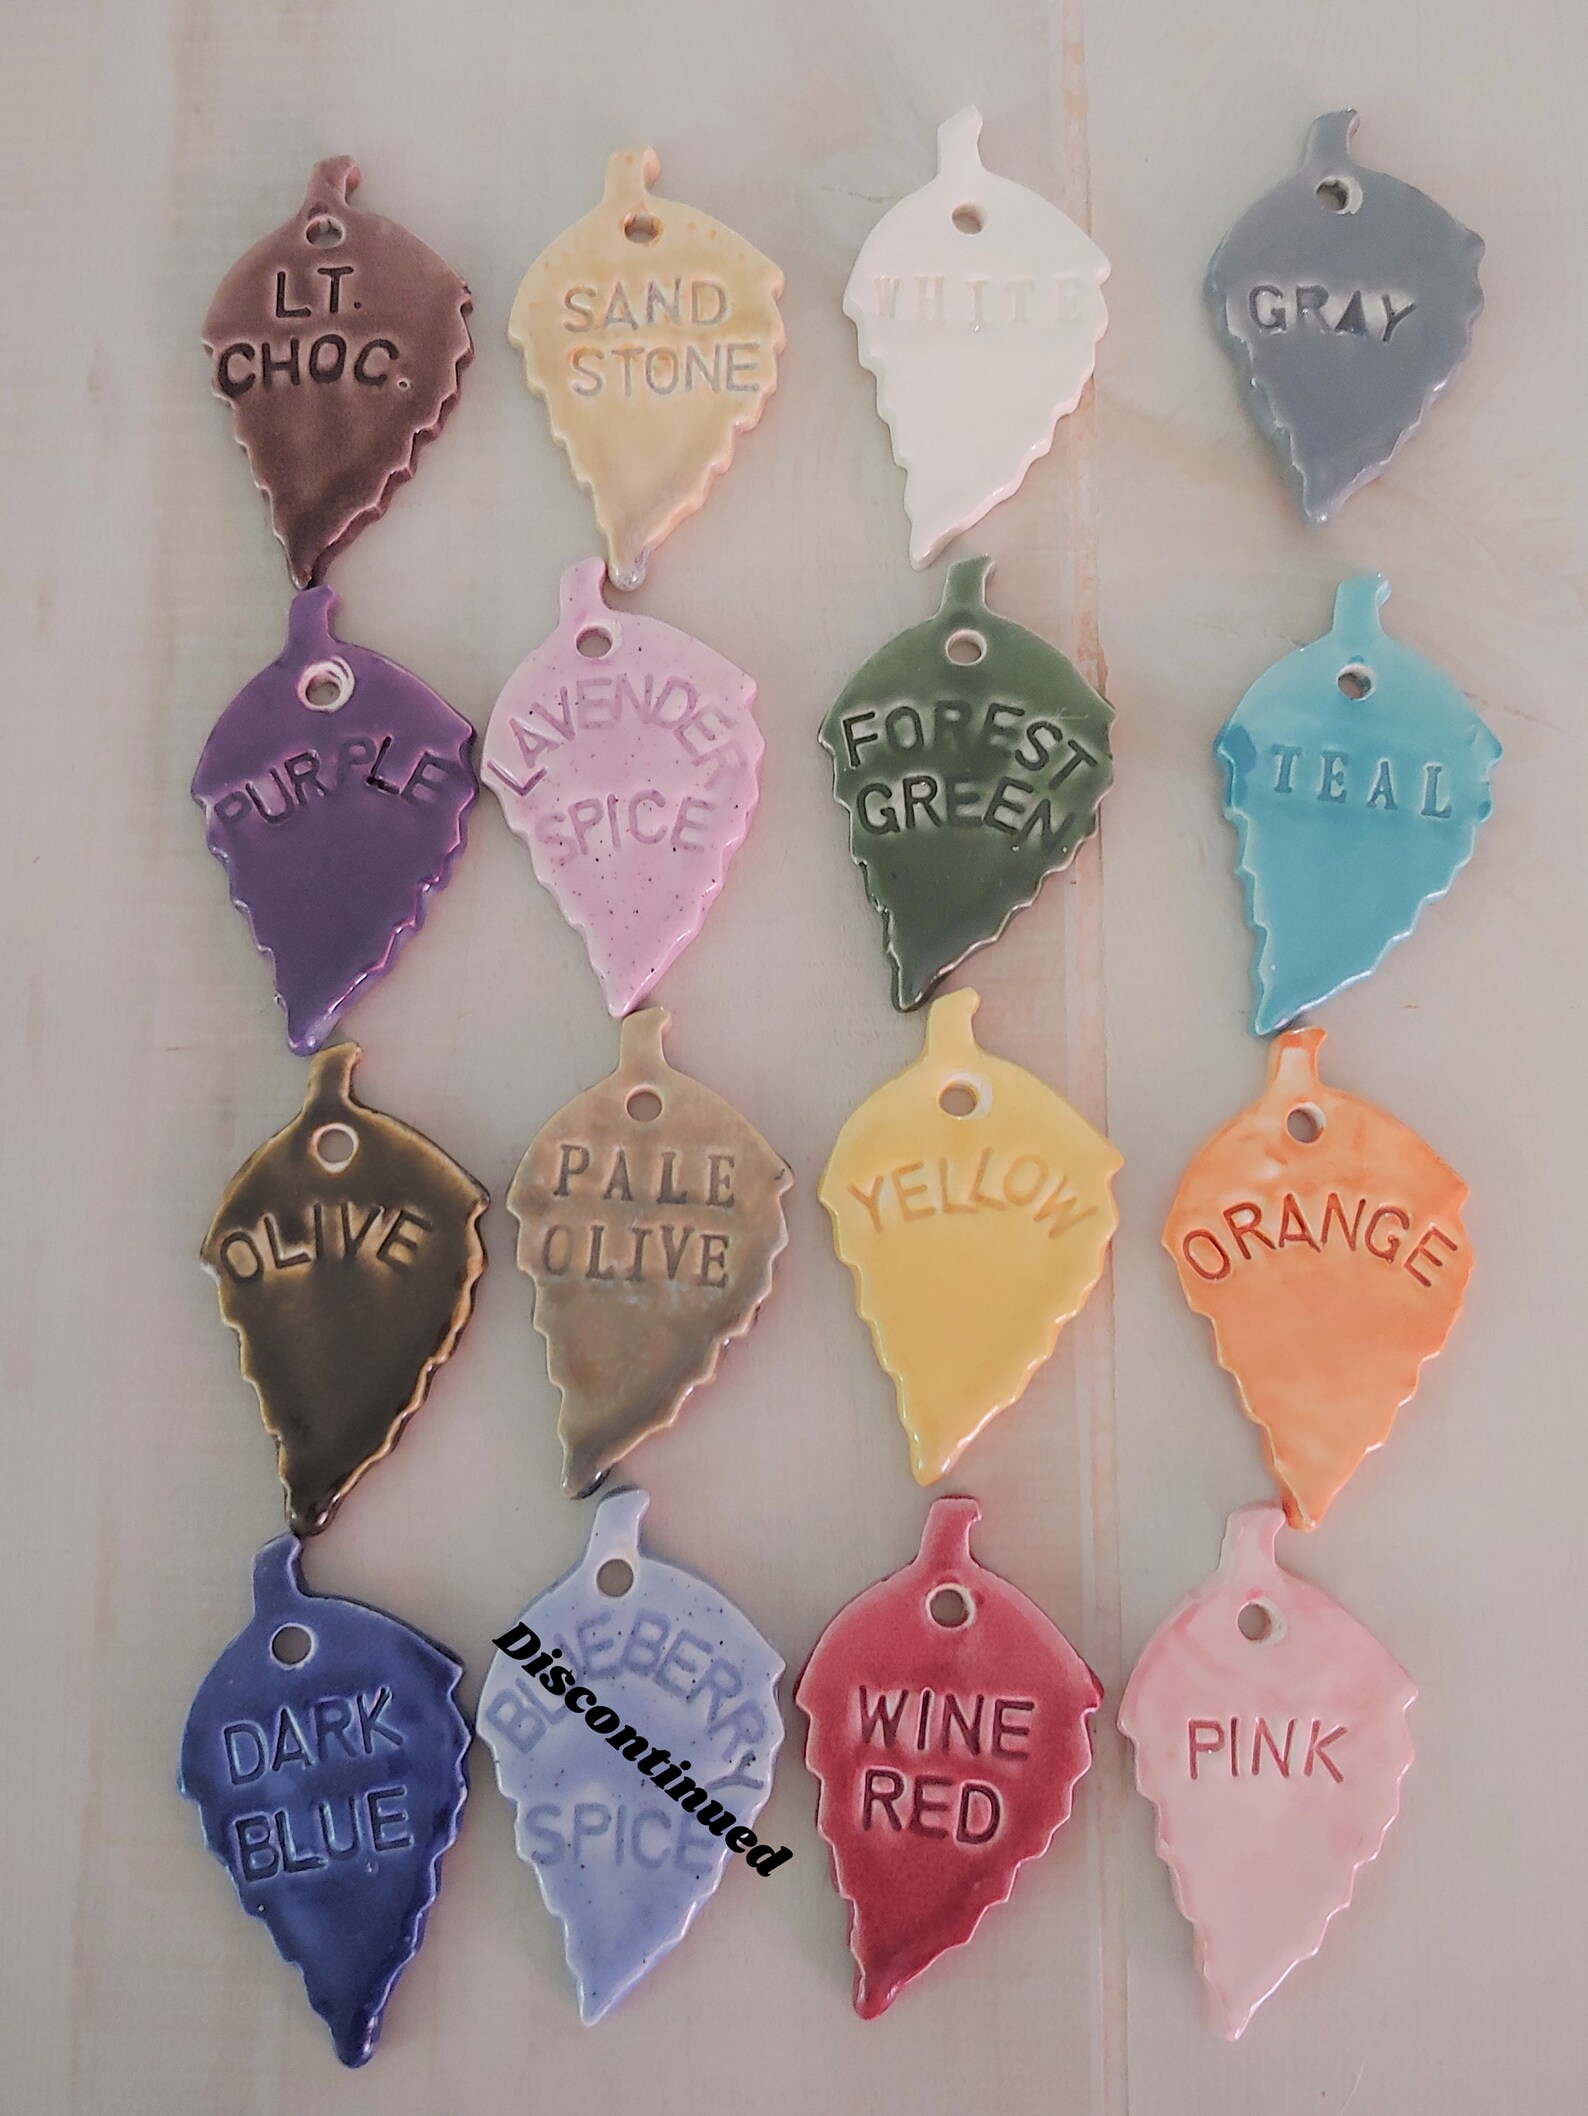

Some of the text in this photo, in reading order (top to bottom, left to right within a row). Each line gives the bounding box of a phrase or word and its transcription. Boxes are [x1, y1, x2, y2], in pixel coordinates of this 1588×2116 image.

[274, 265, 363, 320] LT.
[563, 277, 728, 333] SAND
[873, 275, 1084, 325] WHITE
[1247, 282, 1419, 344] GRAY
[217, 333, 411, 399] CHOC.
[570, 340, 761, 400] STONE
[486, 674, 748, 797] LAVENDER
[842, 699, 1098, 791] FOREST
[214, 735, 451, 831] PURPLE
[855, 775, 1077, 850] GREEN
[1269, 744, 1453, 819] TEAL
[535, 790, 718, 866] SPICE
[553, 1143, 735, 1209] PALE
[848, 1147, 1098, 1240] YELLOW
[218, 1202, 433, 1285] OLIVE
[541, 1224, 731, 1288] OLIVE
[1181, 1192, 1458, 1288] ORANGE
[222, 1686, 404, 1787] DARK
[857, 1684, 1036, 1763] WINE
[1188, 1716, 1350, 1784] PINK
[235, 1785, 413, 1884] BLUE
[522, 1802, 714, 1874] SPICE
[860, 1768, 1001, 1846] RED
